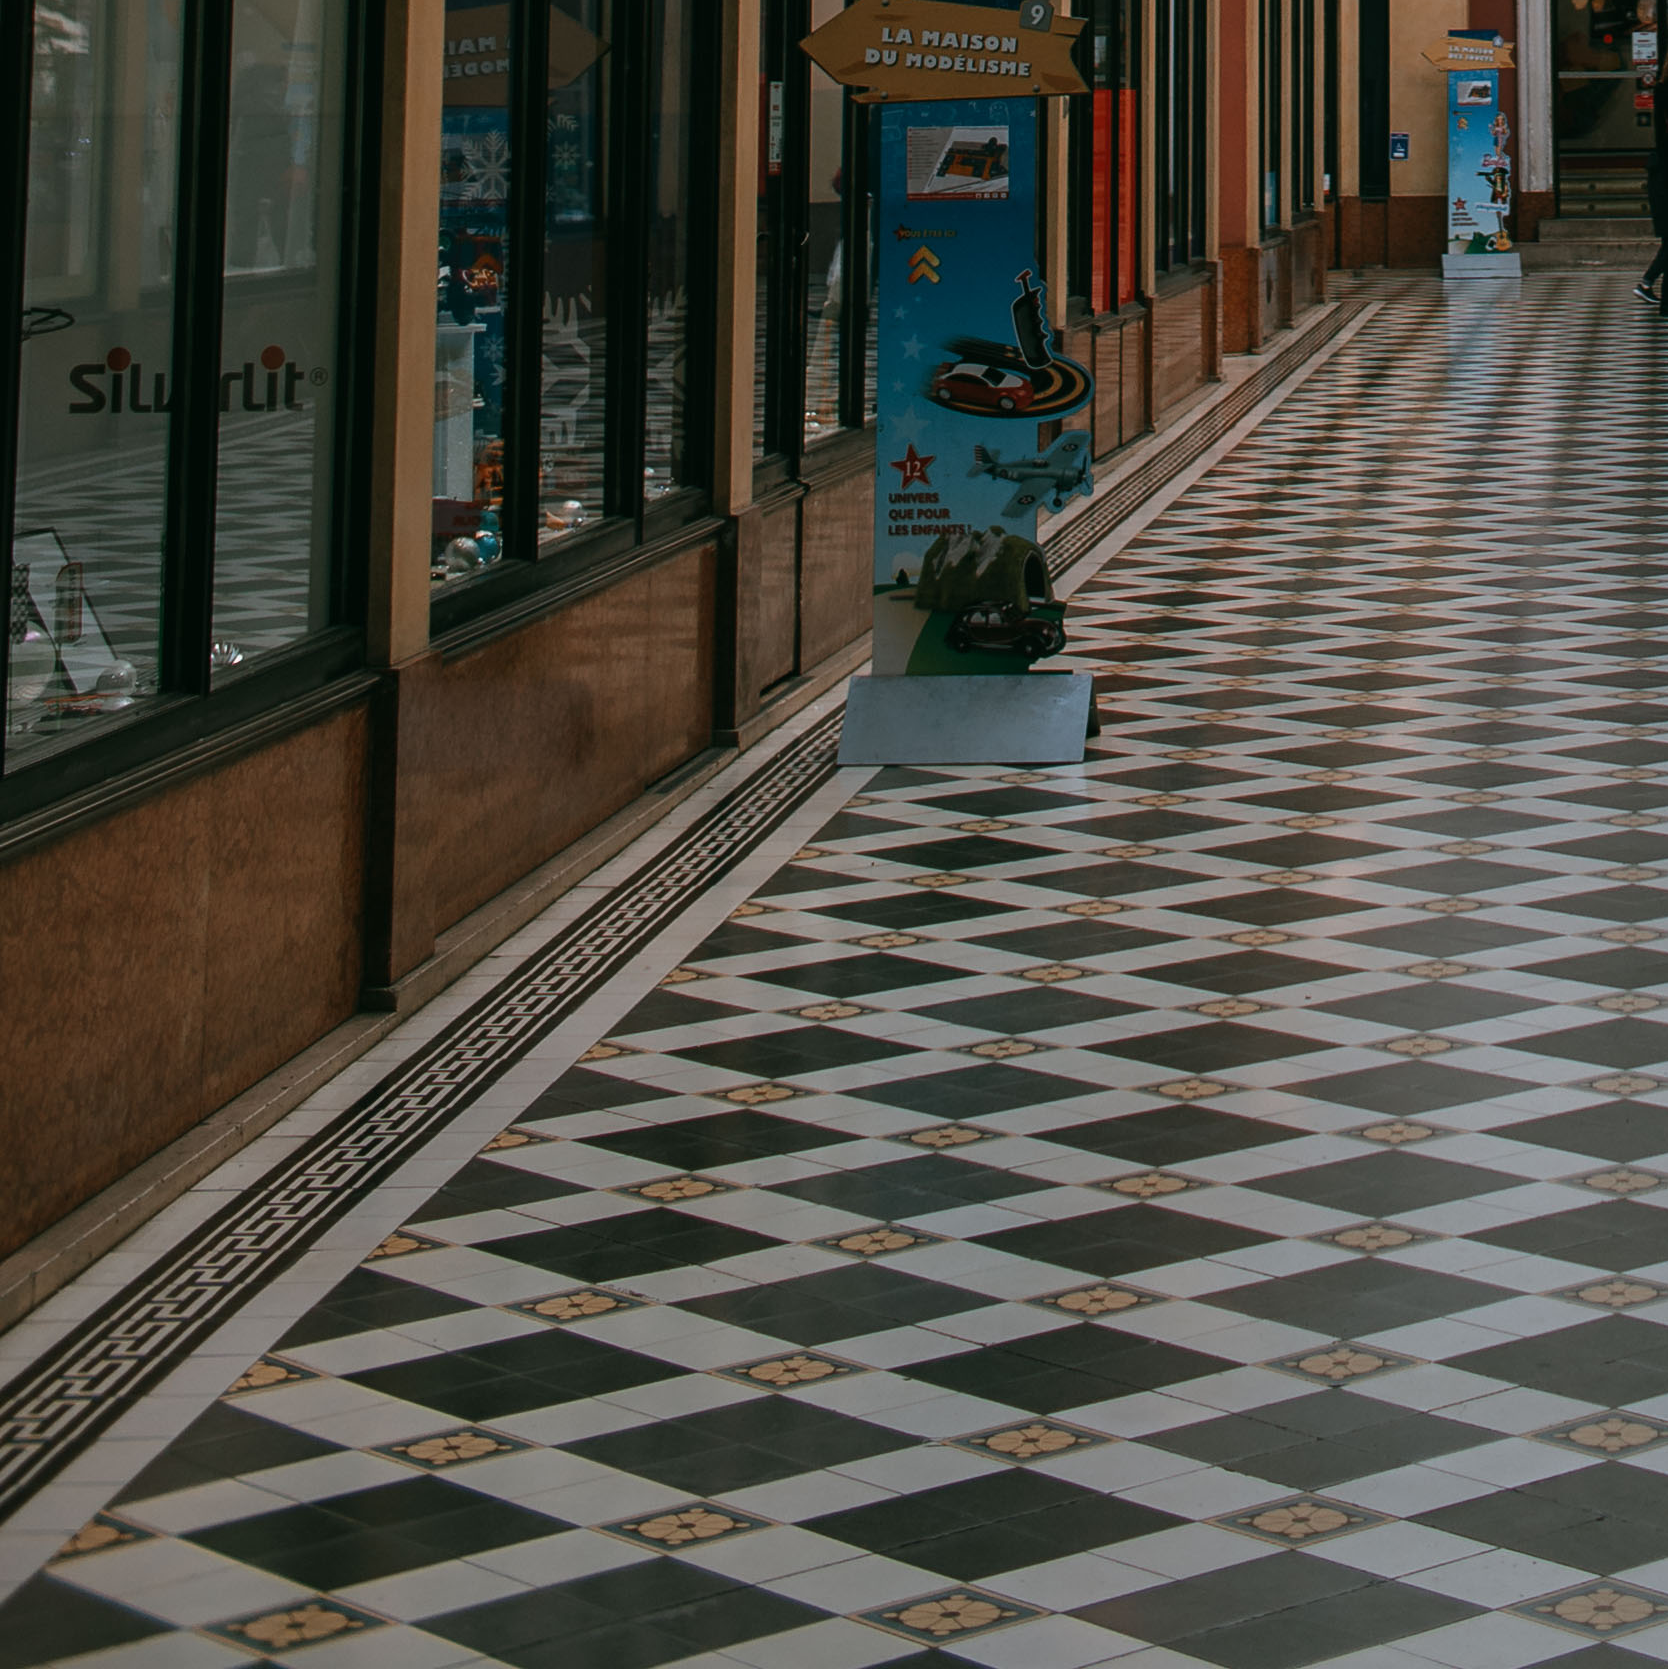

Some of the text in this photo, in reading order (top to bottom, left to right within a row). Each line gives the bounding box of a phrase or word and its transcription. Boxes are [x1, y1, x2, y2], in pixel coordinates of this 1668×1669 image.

[1030, 4, 1045, 26] 9
[881, 27, 1018, 54] LA MAISON
[864, 47, 1032, 78] DU MODÉLISME
[905, 462, 921, 477] 12
[888, 492, 939, 504] UNIVERS
[888, 508, 950, 521] QUE POUR
[888, 524, 909, 536] LES
[911, 523, 965, 536] ENFANTS
